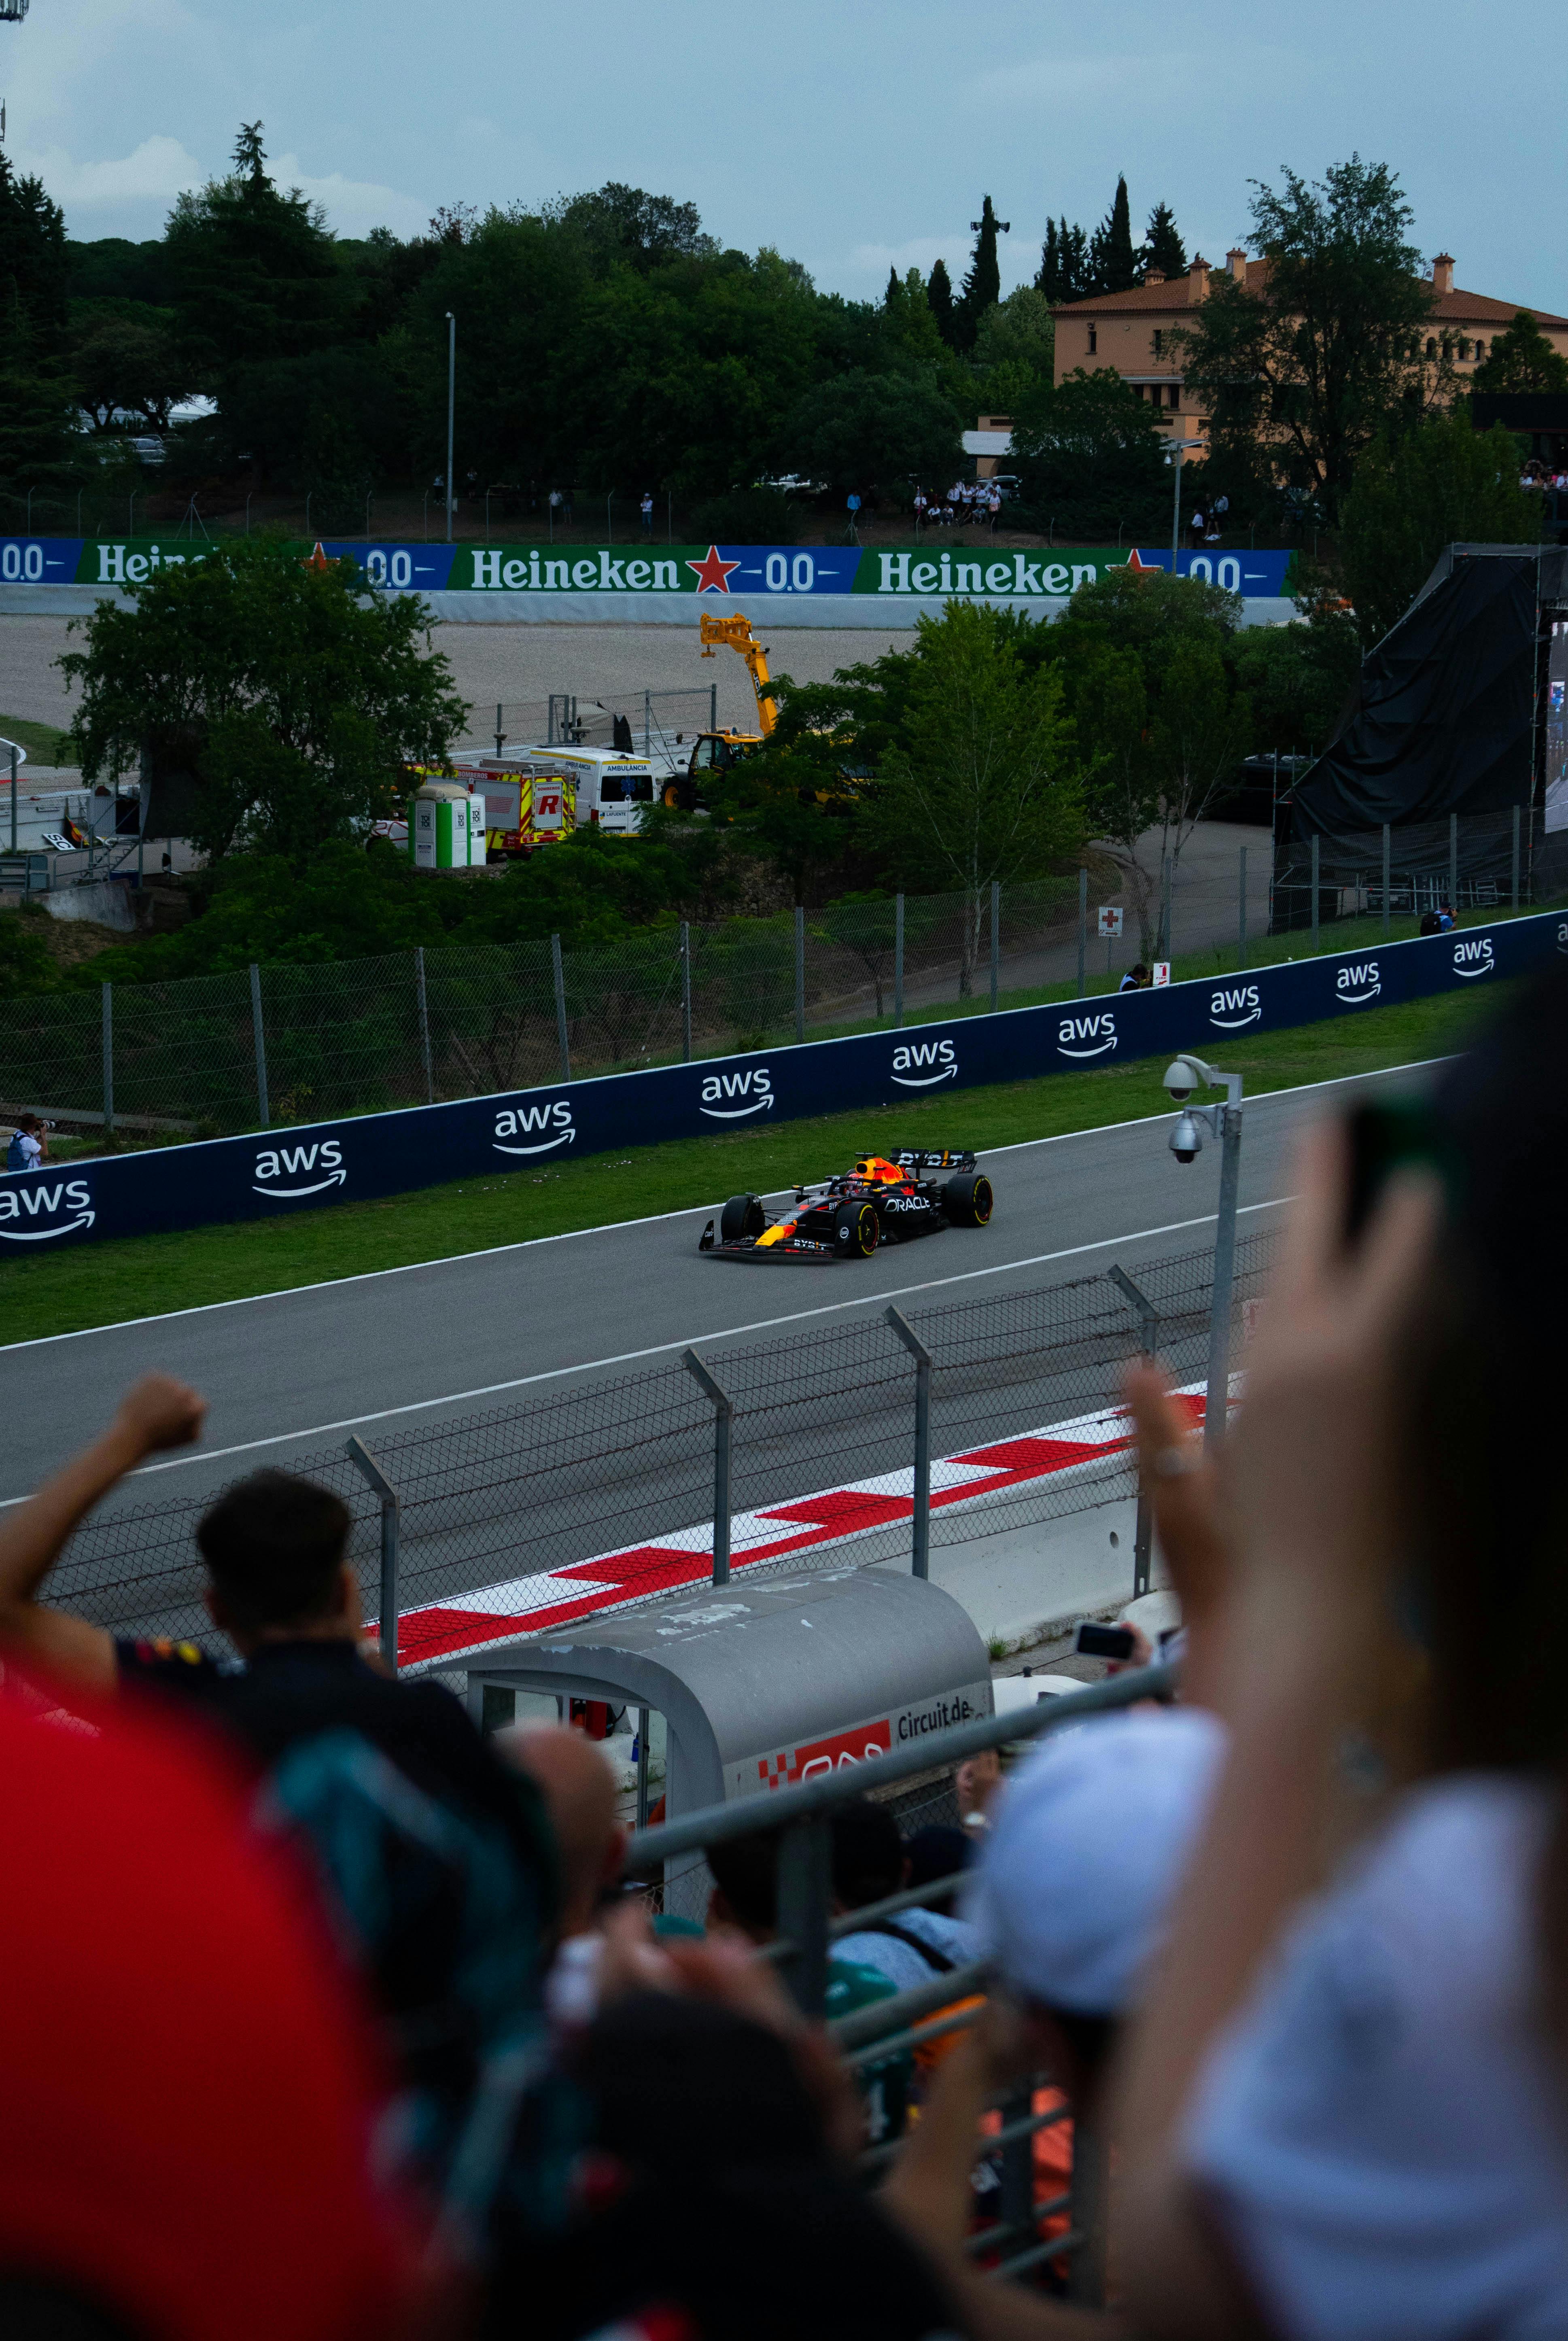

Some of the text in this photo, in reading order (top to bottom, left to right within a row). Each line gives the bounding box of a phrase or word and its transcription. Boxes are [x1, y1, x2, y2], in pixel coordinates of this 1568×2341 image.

[2, 543, 42, 581] 0.0
[471, 550, 814, 592] Heineken 0.0
[878, 553, 1097, 594] Heineken
[458, 771, 488, 779] BOMBEROS
[539, 795, 559, 815] R
[48, 834, 71, 849] SC
[1453, 938, 1493, 963] aws
[1337, 962, 1379, 989] aws
[1211, 985, 1259, 1013] aws
[1059, 1013, 1115, 1042] aws
[893, 1040, 955, 1070] aws
[702, 1069, 770, 1101] aws
[495, 1101, 572, 1137] aws
[255, 1140, 342, 1179] aws
[0, 1180, 90, 1220] aws
[884, 1196, 930, 1212] ORACLE
[898, 1702, 951, 1740] Circuit
